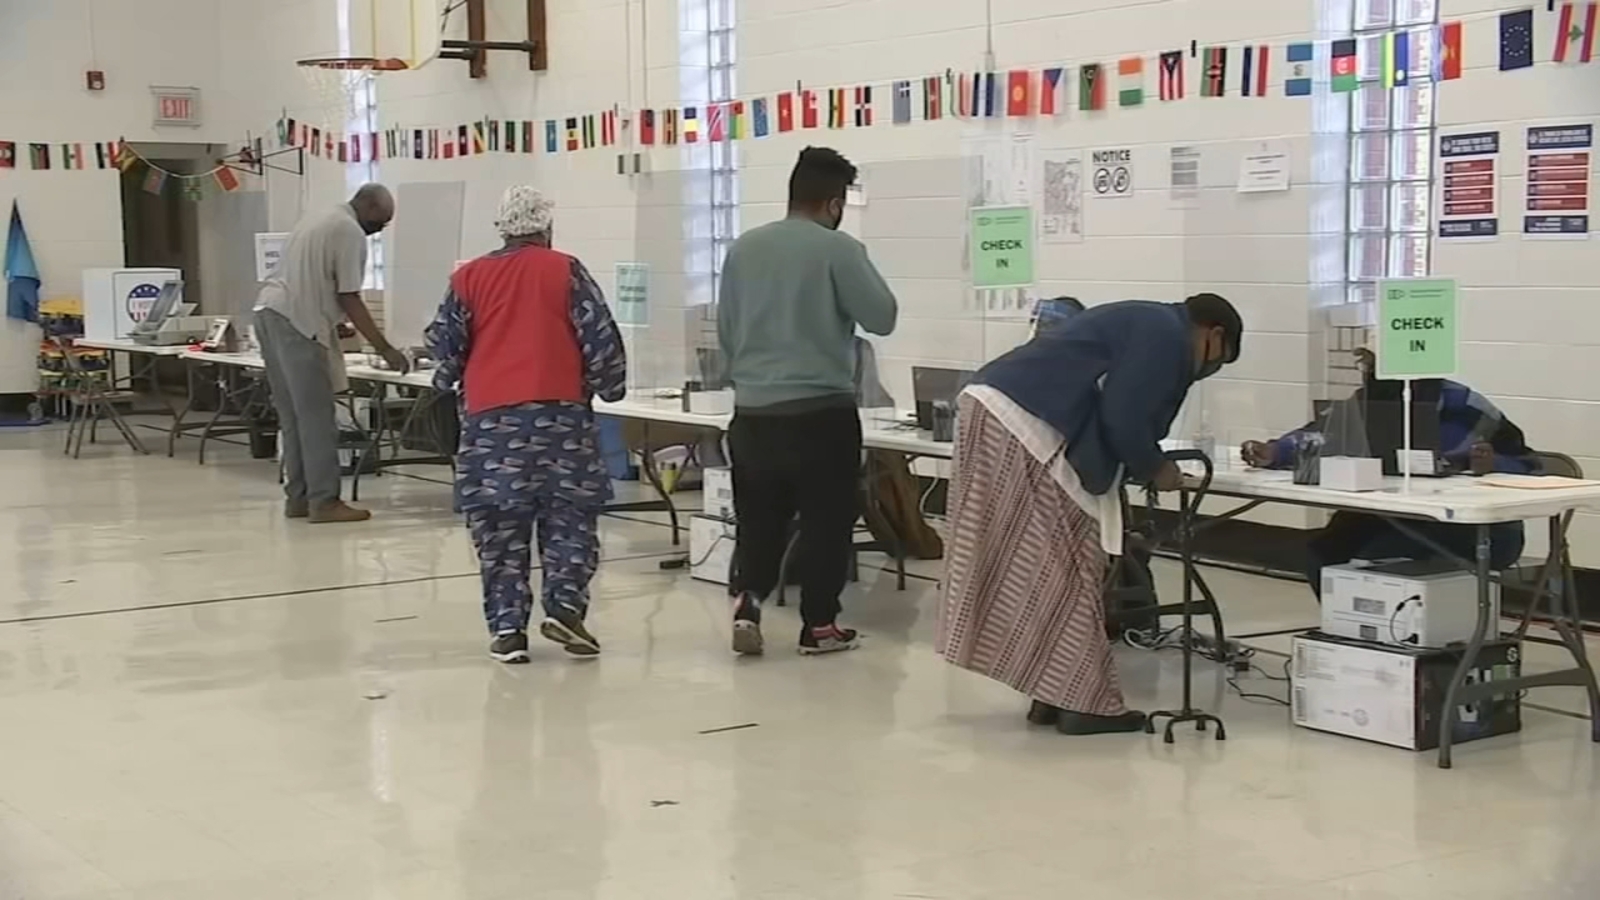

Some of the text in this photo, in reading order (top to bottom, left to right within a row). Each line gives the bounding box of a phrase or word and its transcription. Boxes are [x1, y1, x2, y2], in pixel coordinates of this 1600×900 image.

[163, 99, 189, 118] EXIT
[1093, 150, 1130, 163] NOTICE
[981, 240, 1023, 250] CHECK
[996, 259, 1009, 268] IN
[1391, 317, 1444, 330] CHECK
[1410, 340, 1425, 352] IN
